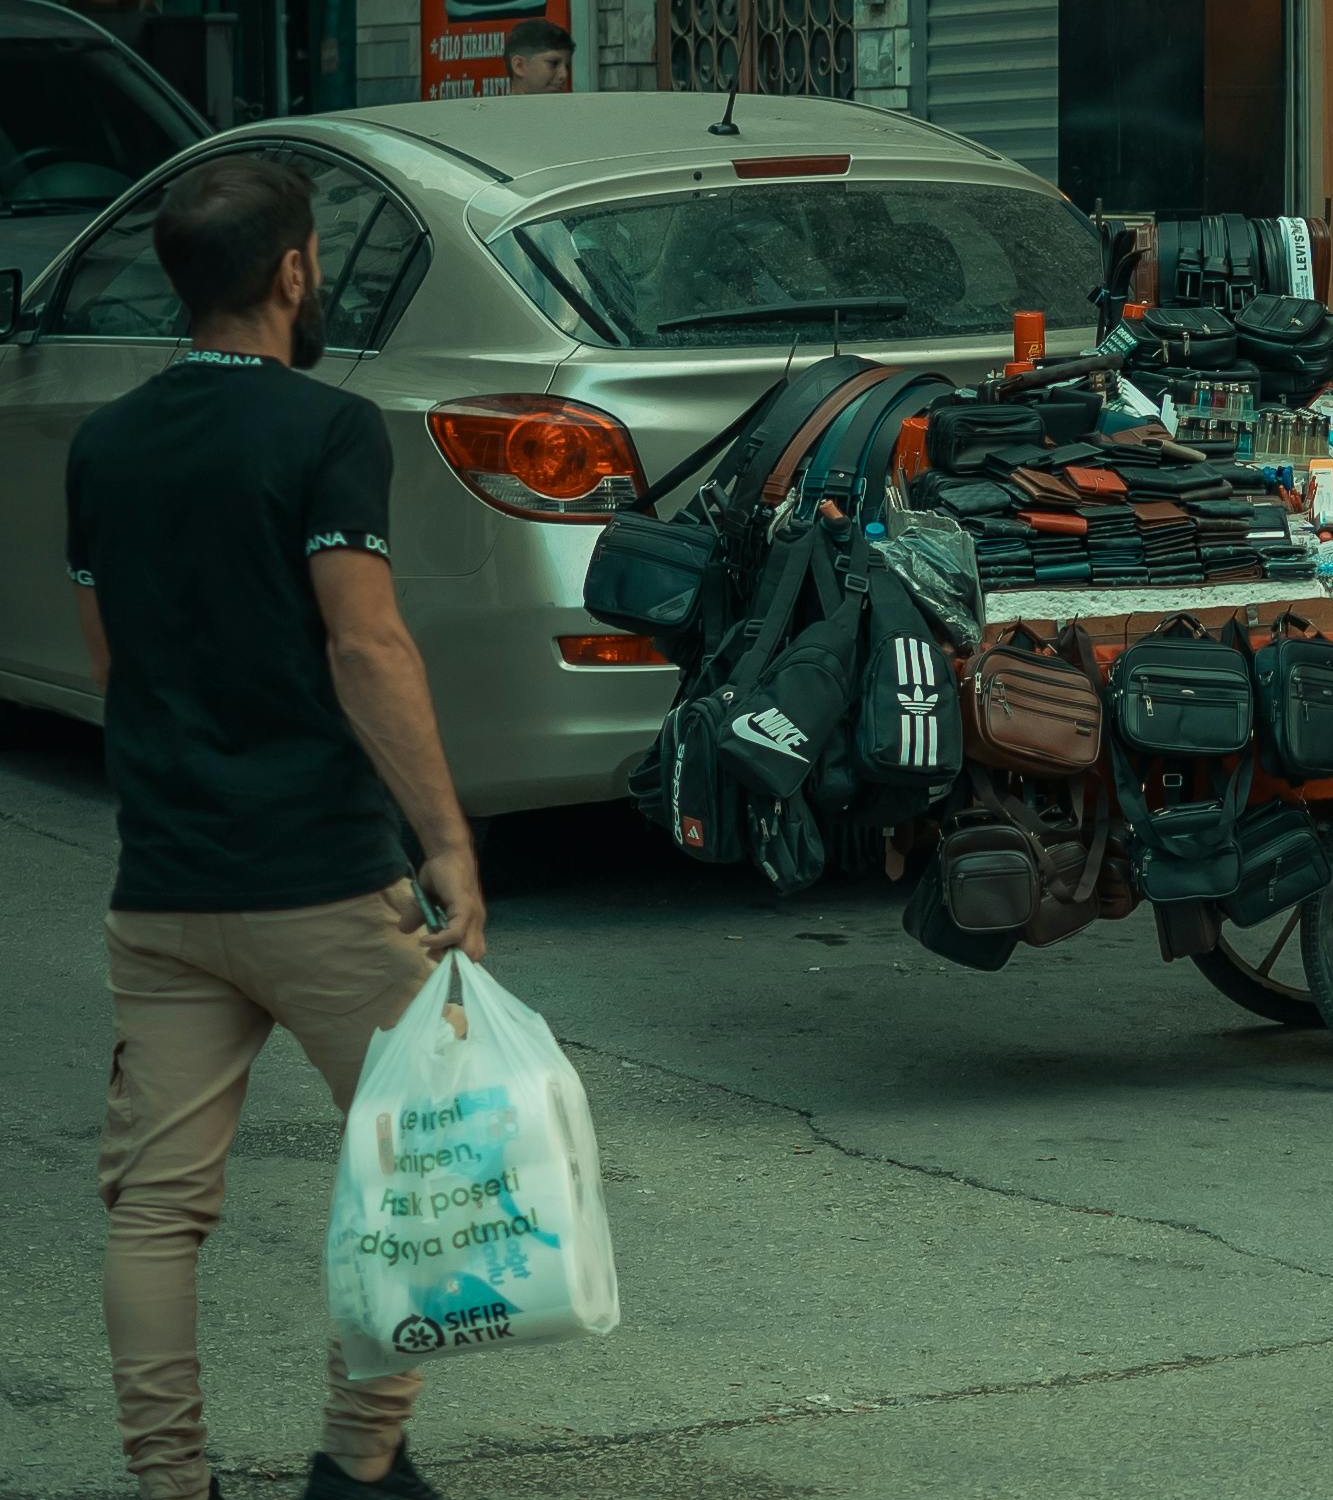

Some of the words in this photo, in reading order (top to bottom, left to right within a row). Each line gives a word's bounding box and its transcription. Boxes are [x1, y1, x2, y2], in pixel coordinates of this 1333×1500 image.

[751, 707, 809, 752] NIKE
[672, 743, 685, 846] adidas
[430, 1166, 520, 1219] poşeti
[445, 1301, 508, 1331] SIFIR
[454, 1322, 515, 1346] ATIK
